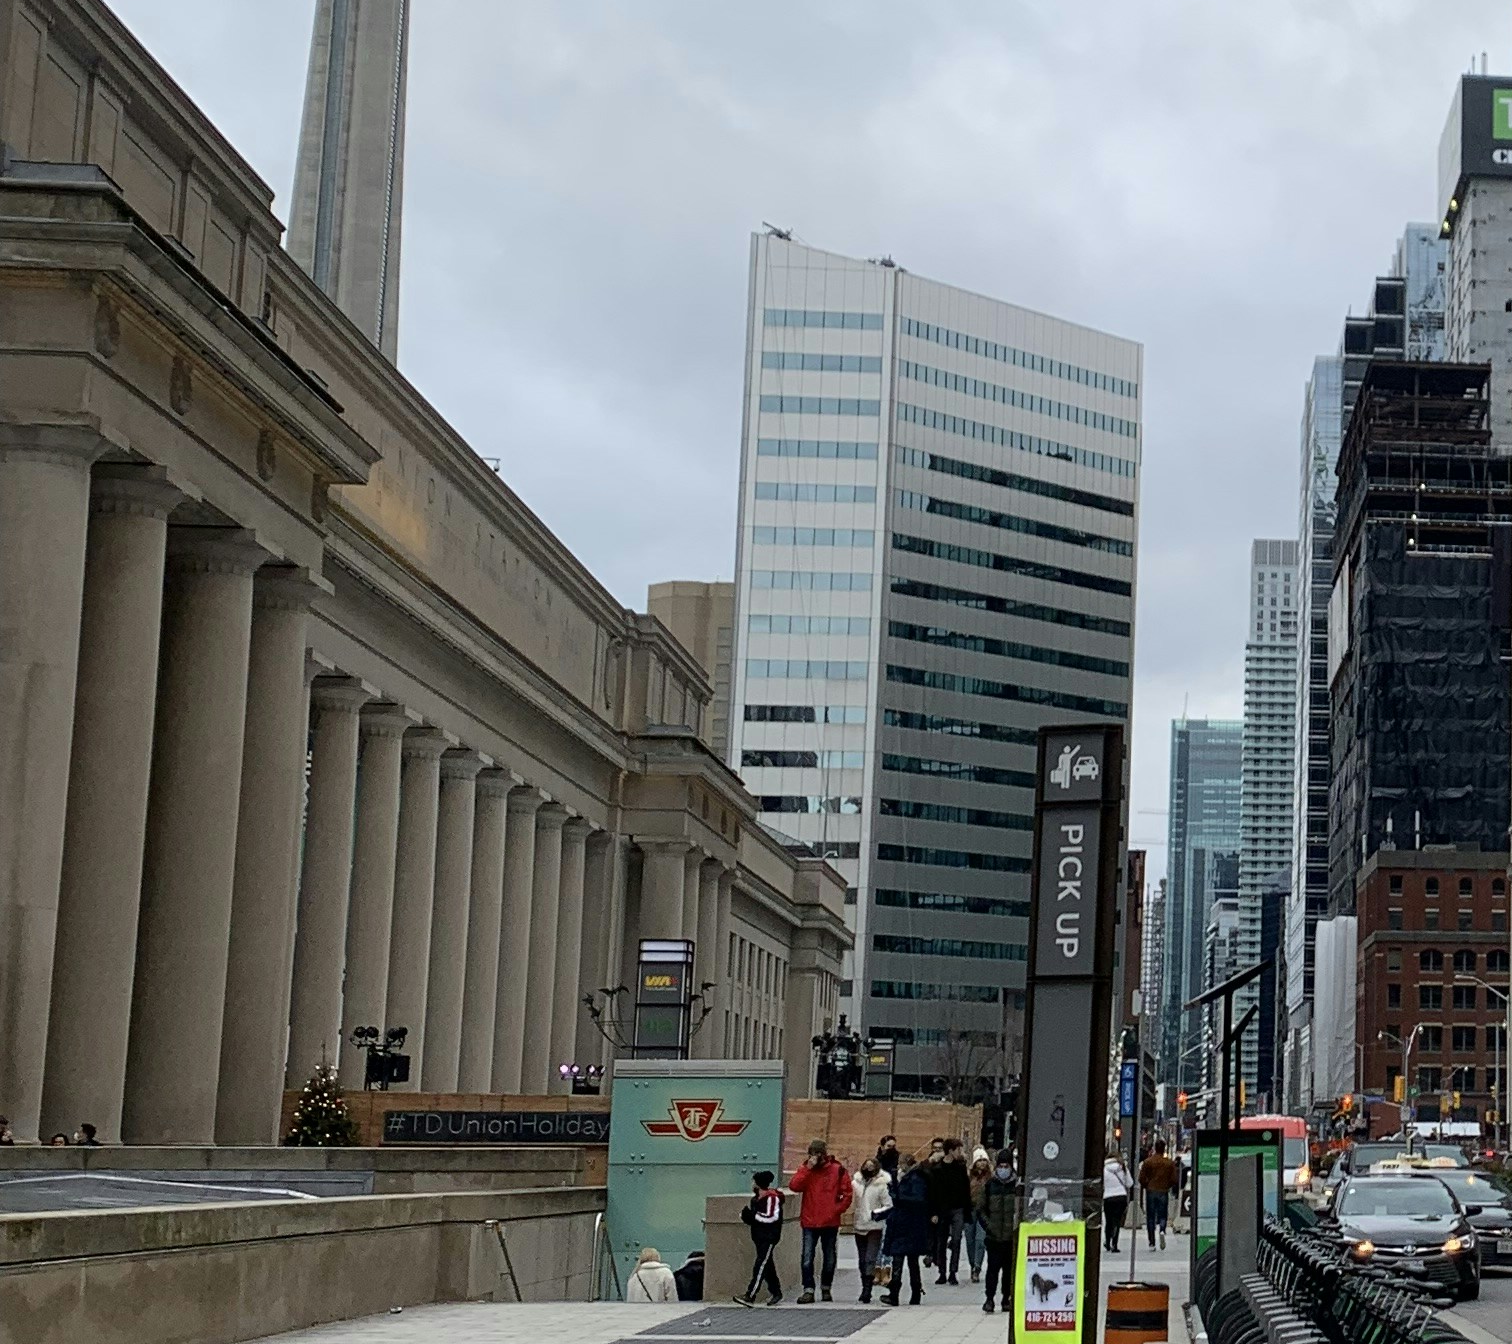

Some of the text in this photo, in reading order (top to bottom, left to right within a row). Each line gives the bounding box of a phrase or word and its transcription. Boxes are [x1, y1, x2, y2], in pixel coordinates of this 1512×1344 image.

[1055, 824, 1084, 958] PICK UP
[1029, 1239, 1076, 1253] MISSING
